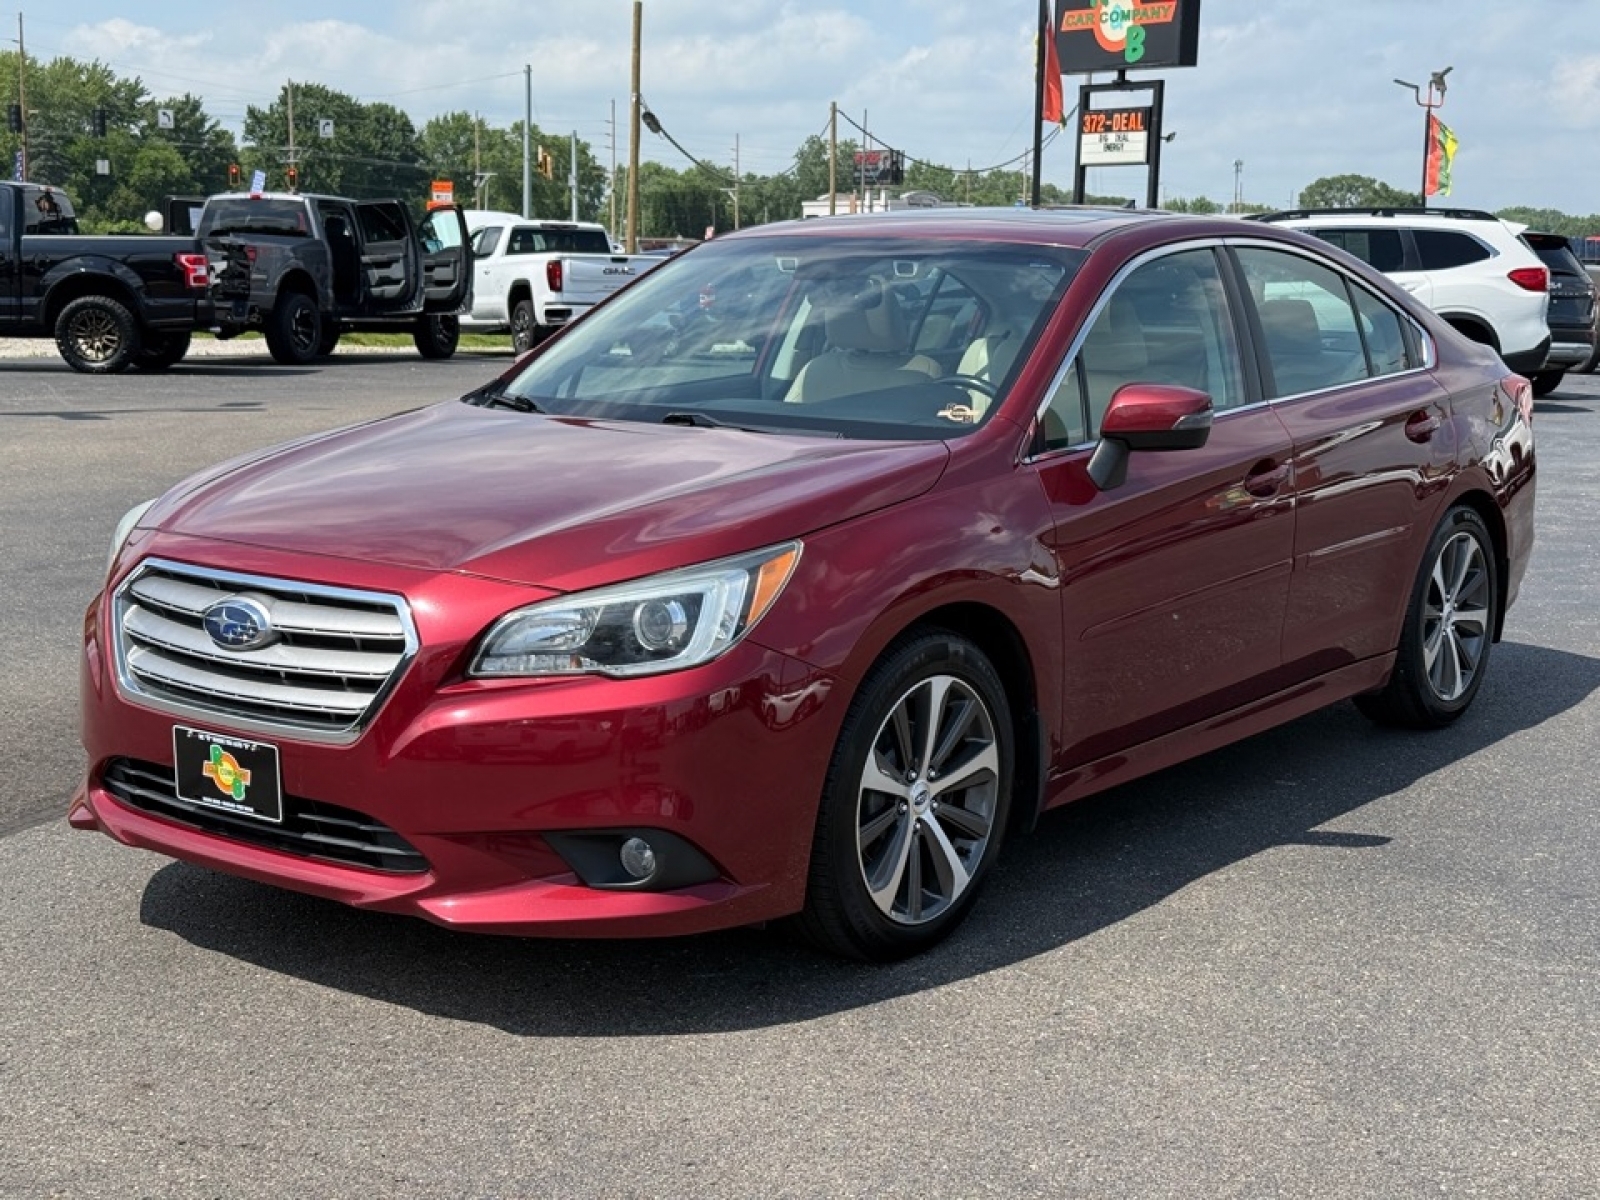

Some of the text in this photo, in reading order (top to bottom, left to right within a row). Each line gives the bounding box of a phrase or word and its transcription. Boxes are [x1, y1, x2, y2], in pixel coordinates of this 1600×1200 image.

[1066, 13, 1094, 26] CAR
[1100, 5, 1171, 24] COMPANY
[1125, 25, 1146, 63] B
[1082, 112, 1144, 133] 372-DEAL
[603, 268, 636, 276] GMC
